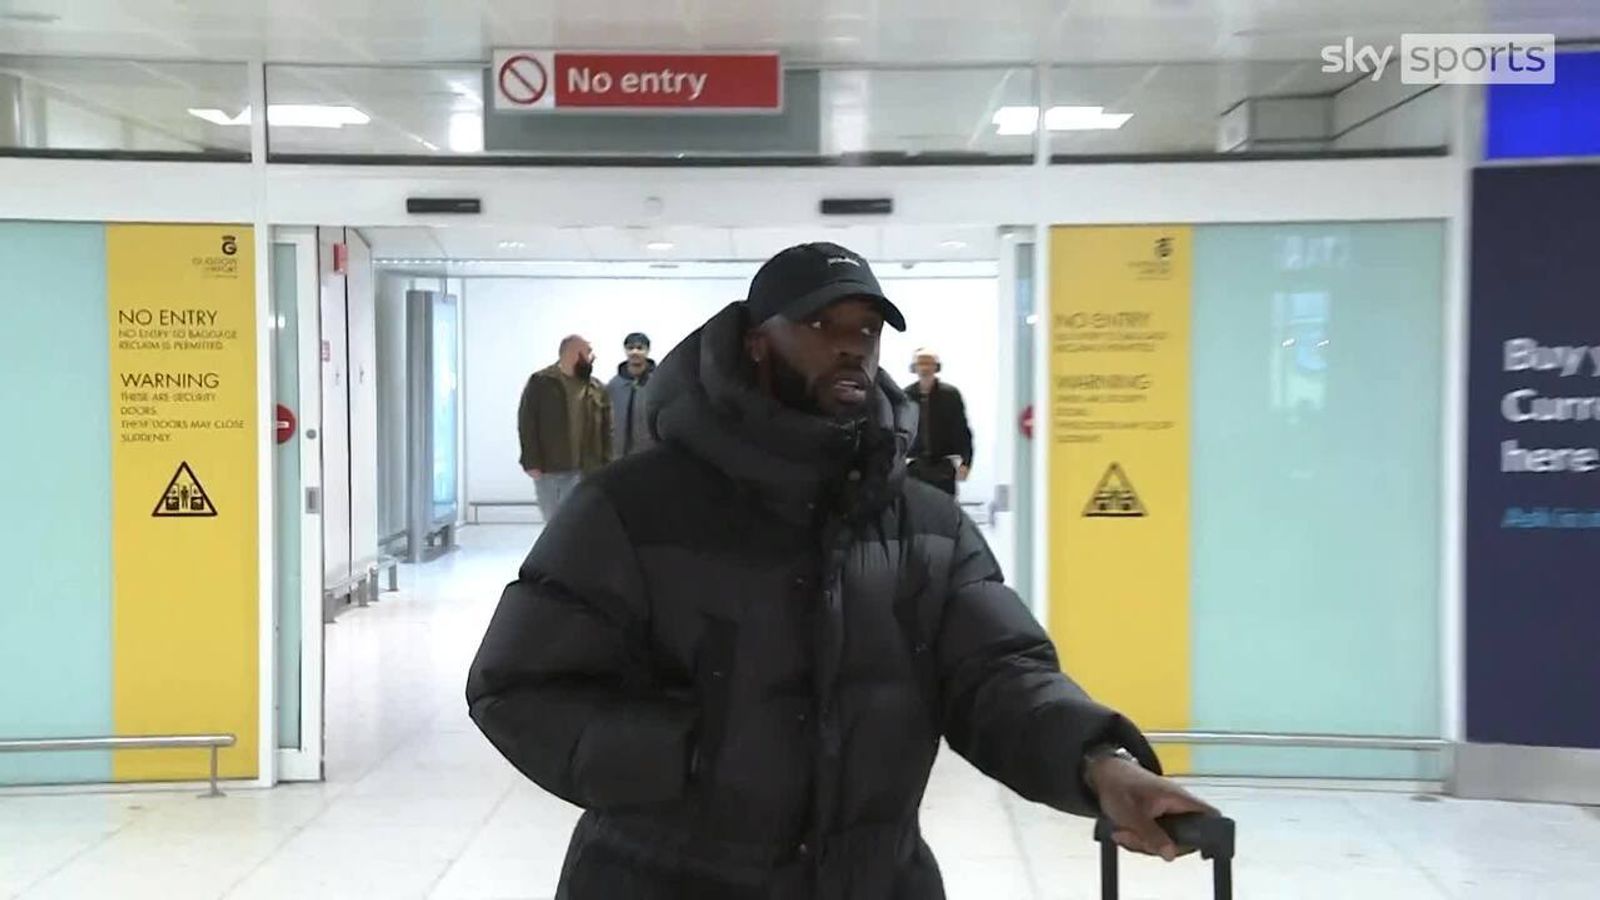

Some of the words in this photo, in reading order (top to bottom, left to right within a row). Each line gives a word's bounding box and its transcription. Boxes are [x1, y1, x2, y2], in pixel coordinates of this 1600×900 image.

[566, 67, 612, 93] No
[620, 68, 708, 100] entry
[118, 309, 153, 325] NO
[159, 309, 218, 325] ENTRY
[118, 329, 137, 338] NO
[1503, 337, 1587, 377] Buy
[120, 373, 219, 389] WARNING
[191, 419, 211, 429] MAY
[214, 419, 244, 429] CLOSE
